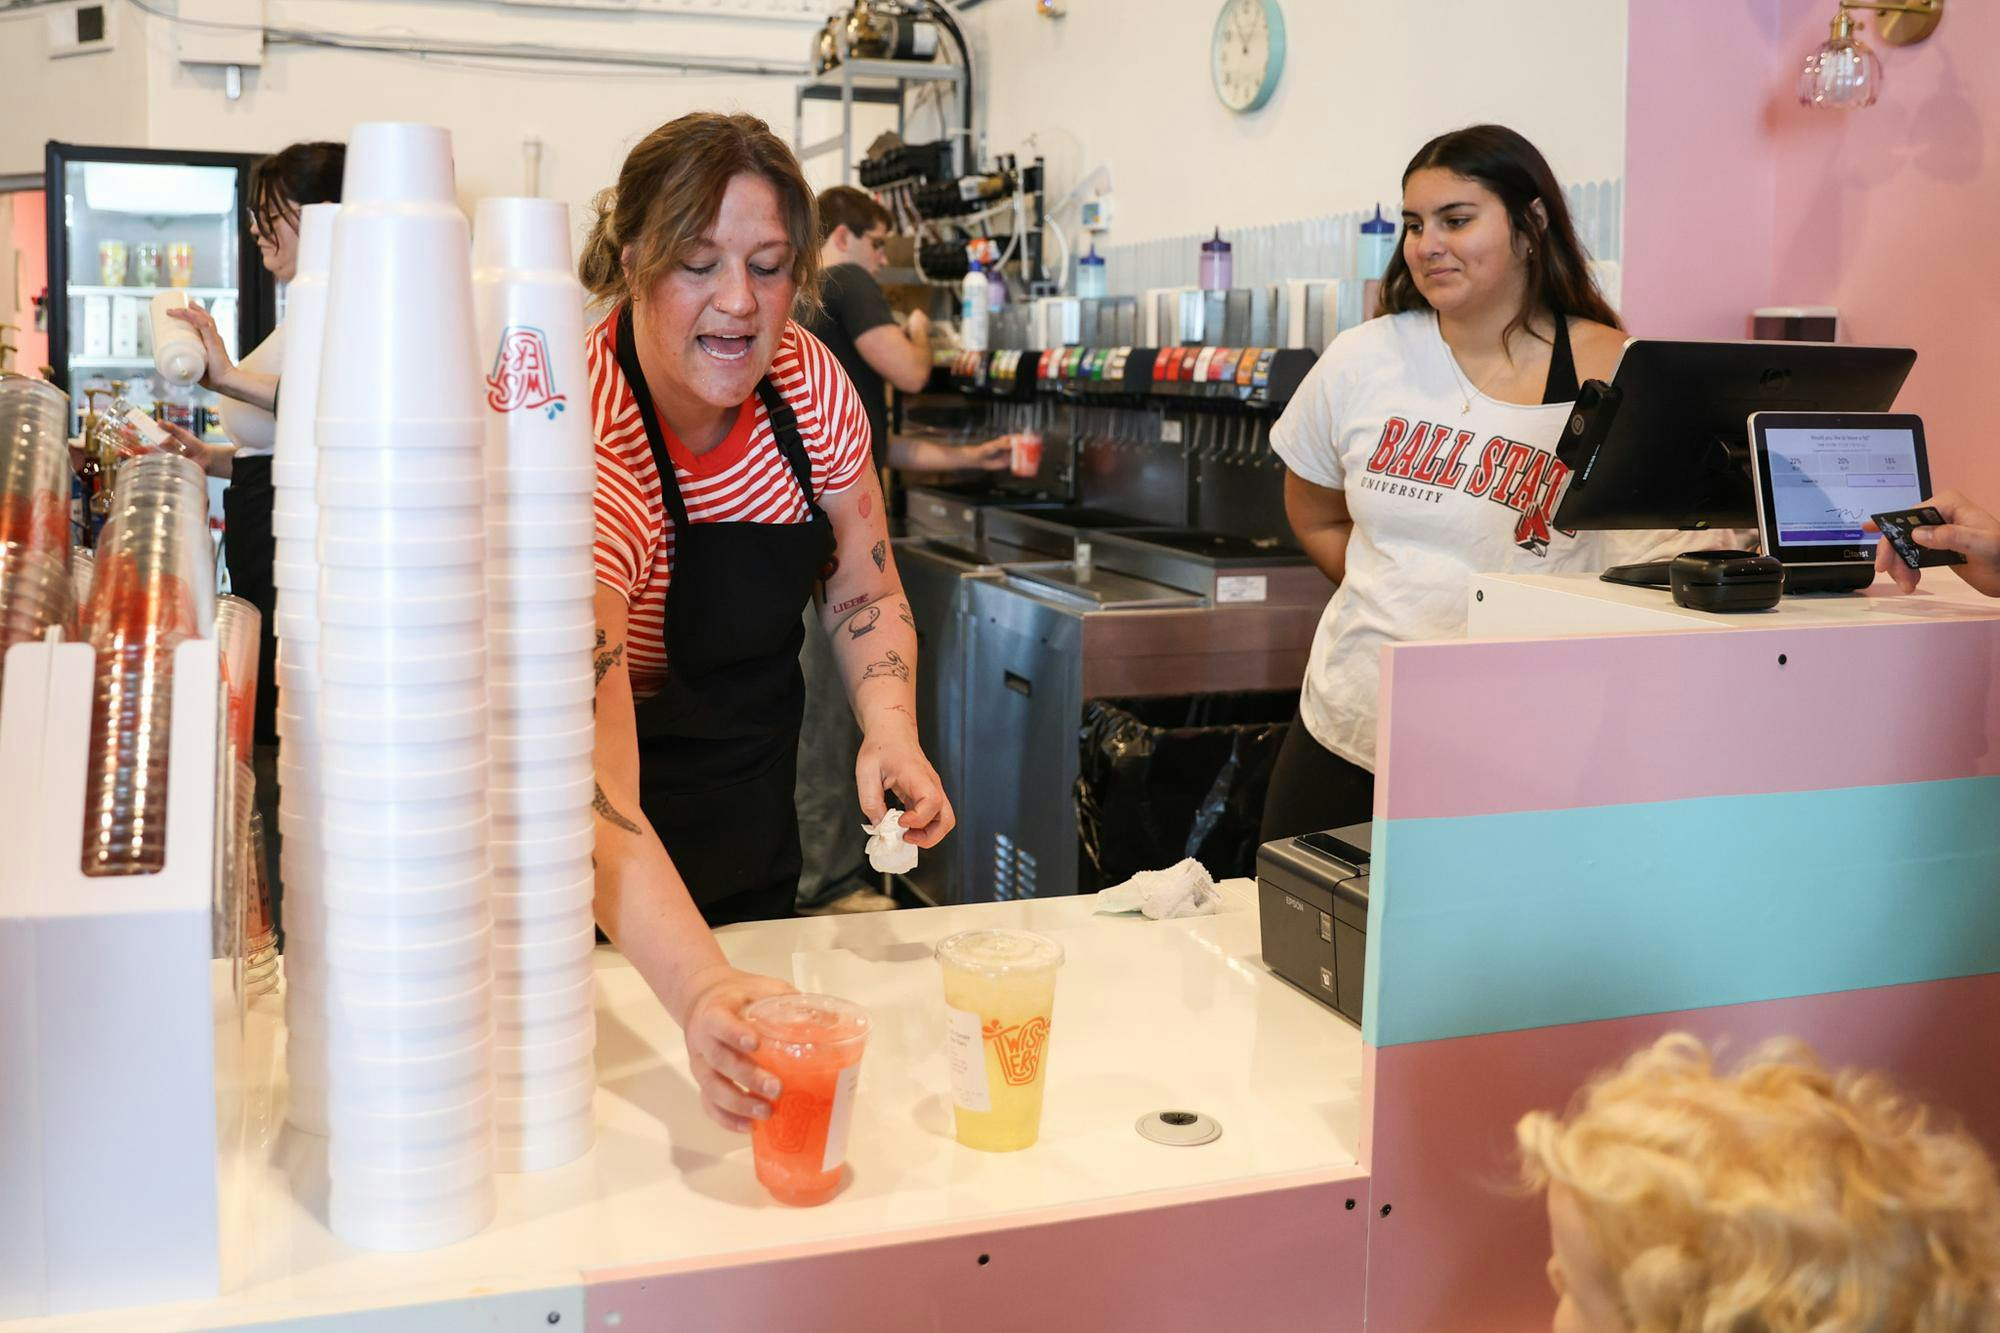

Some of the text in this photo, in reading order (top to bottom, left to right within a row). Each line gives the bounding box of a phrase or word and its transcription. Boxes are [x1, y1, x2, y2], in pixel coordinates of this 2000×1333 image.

[1360, 476, 1444, 504] UNIVERSITY
[1366, 416, 1578, 539] BALL STAT
[1284, 895, 1304, 913] EPSON
